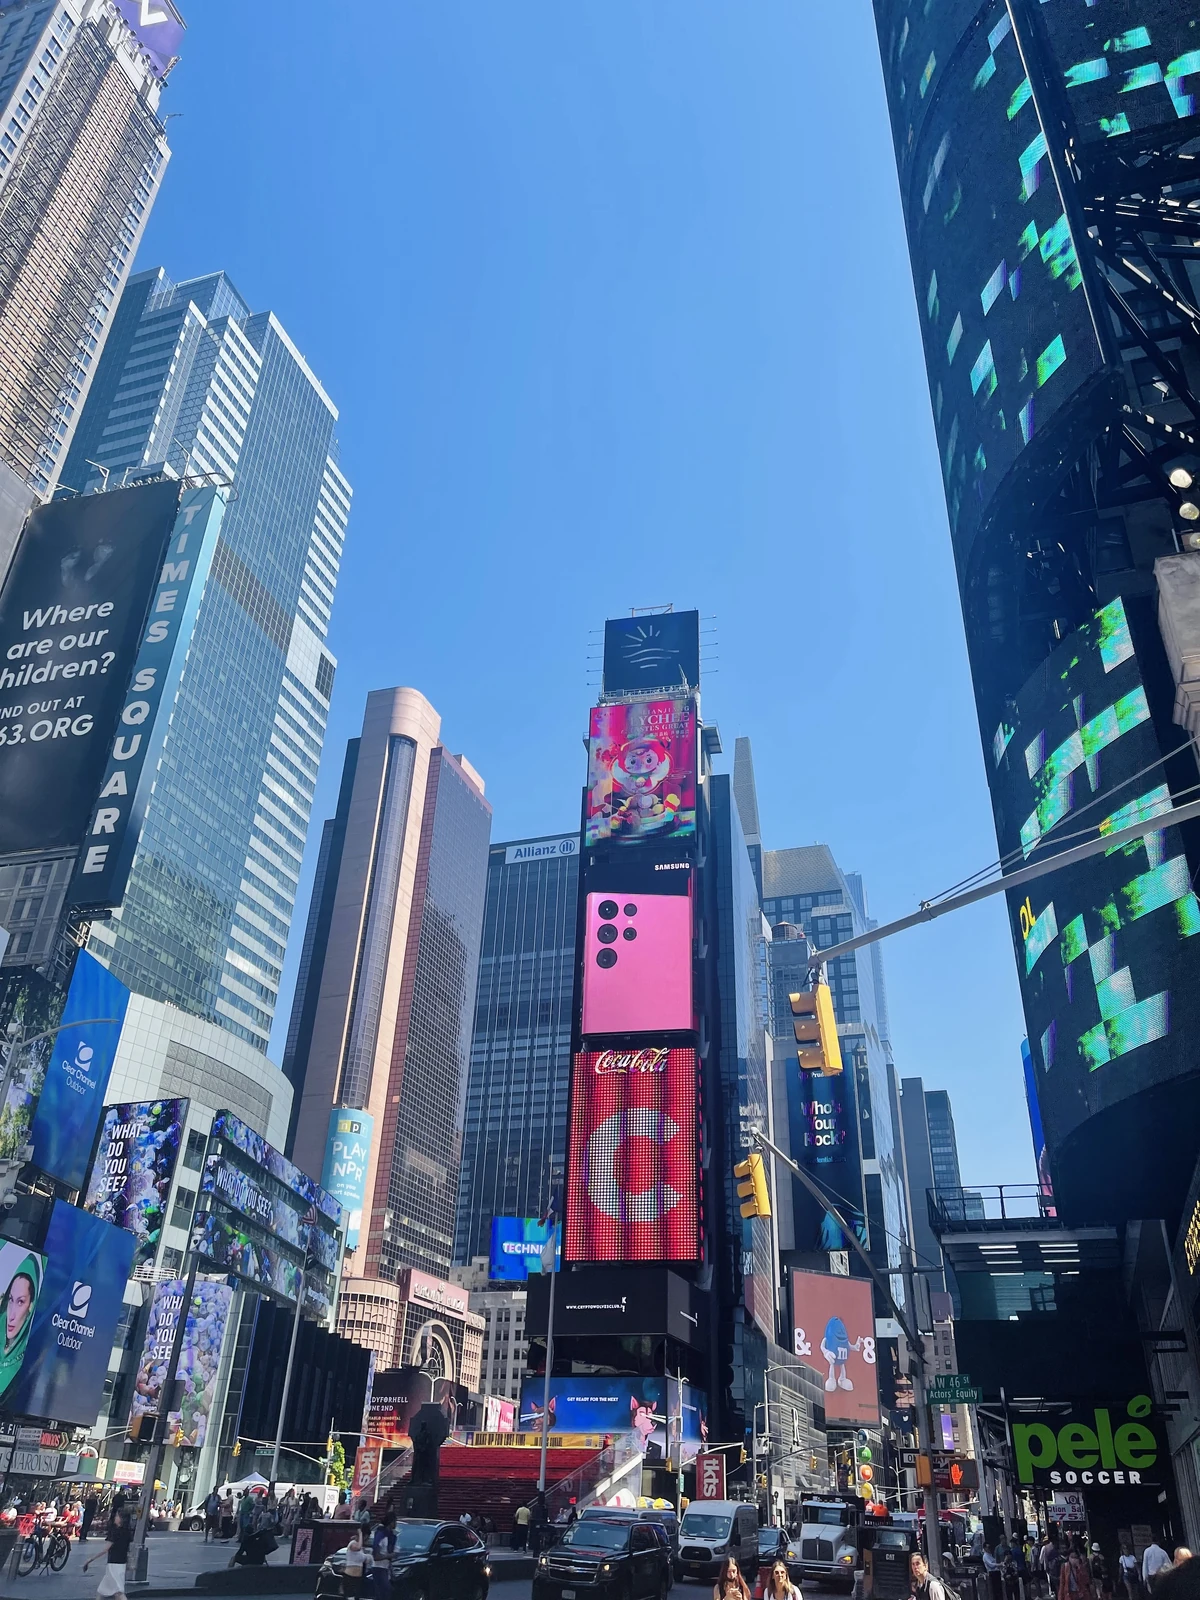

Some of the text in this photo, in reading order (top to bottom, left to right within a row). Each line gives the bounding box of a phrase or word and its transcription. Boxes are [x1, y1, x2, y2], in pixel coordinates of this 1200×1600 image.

[145, 504, 201, 644] TIMES
[23, 601, 114, 630] Where
[6, 629, 109, 660] are our
[0, 696, 85, 719] ND OUT AT
[82, 667, 157, 874] SQUARE
[514, 844, 557, 859] Allianz
[654, 863, 690, 871] SAMSUNG
[62, 1060, 96, 1089] Clear Channel
[66, 1076, 86, 1095] Outdoor
[112, 1123, 143, 1139] WHAT
[804, 1131, 846, 1147] Rock?
[107, 1141, 124, 1157] DO
[104, 1158, 127, 1174] YOU
[98, 1175, 127, 1192] SEE?
[245, 1186, 257, 1209] YOU
[257, 1195, 271, 1218] SEE?
[503, 1242, 561, 1255] TECHNI
[163, 1296, 184, 1309] WH
[52, 1313, 96, 1337] Clear Channel
[159, 1312, 173, 1327] DO
[57, 1332, 83, 1350] Outdoor
[156, 1328, 177, 1343] YOU
[936, 1378, 945, 1388] W
[949, 1377, 960, 1388] 46
[930, 1389, 978, 1399] Actors' Equity
[1012, 1395, 1157, 1484] pelé
[358, 1451, 376, 1487] tkts
[703, 1458, 720, 1497] tkts
[1050, 1471, 1141, 1484] SOCCER
